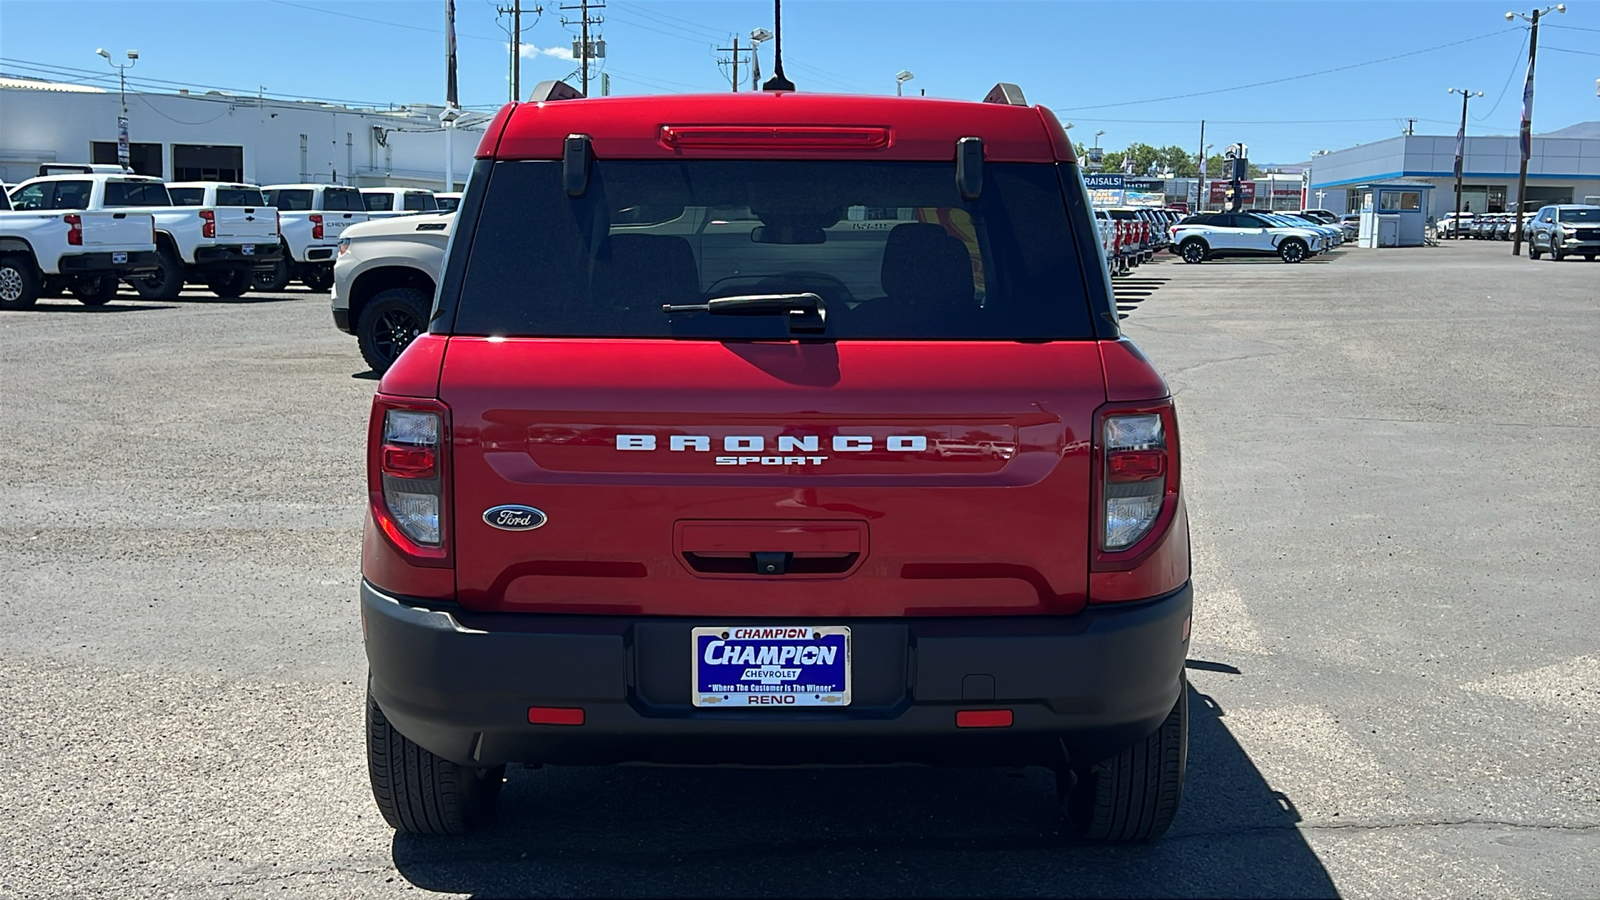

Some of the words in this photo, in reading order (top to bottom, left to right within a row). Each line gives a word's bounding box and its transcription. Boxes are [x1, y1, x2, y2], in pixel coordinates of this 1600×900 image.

[616, 434, 927, 452] BRONCO
[715, 456, 828, 466] SPORT
[496, 509, 532, 526] Ford
[734, 628, 808, 639] CHAMPION
[704, 640, 837, 665] CHAMPION
[745, 670, 797, 678] CHEVROLET
[736, 684, 749, 692] The
[750, 684, 784, 692] Customer
[785, 684, 791, 692] Is
[793, 684, 805, 692] The
[748, 695, 796, 705] RENO
